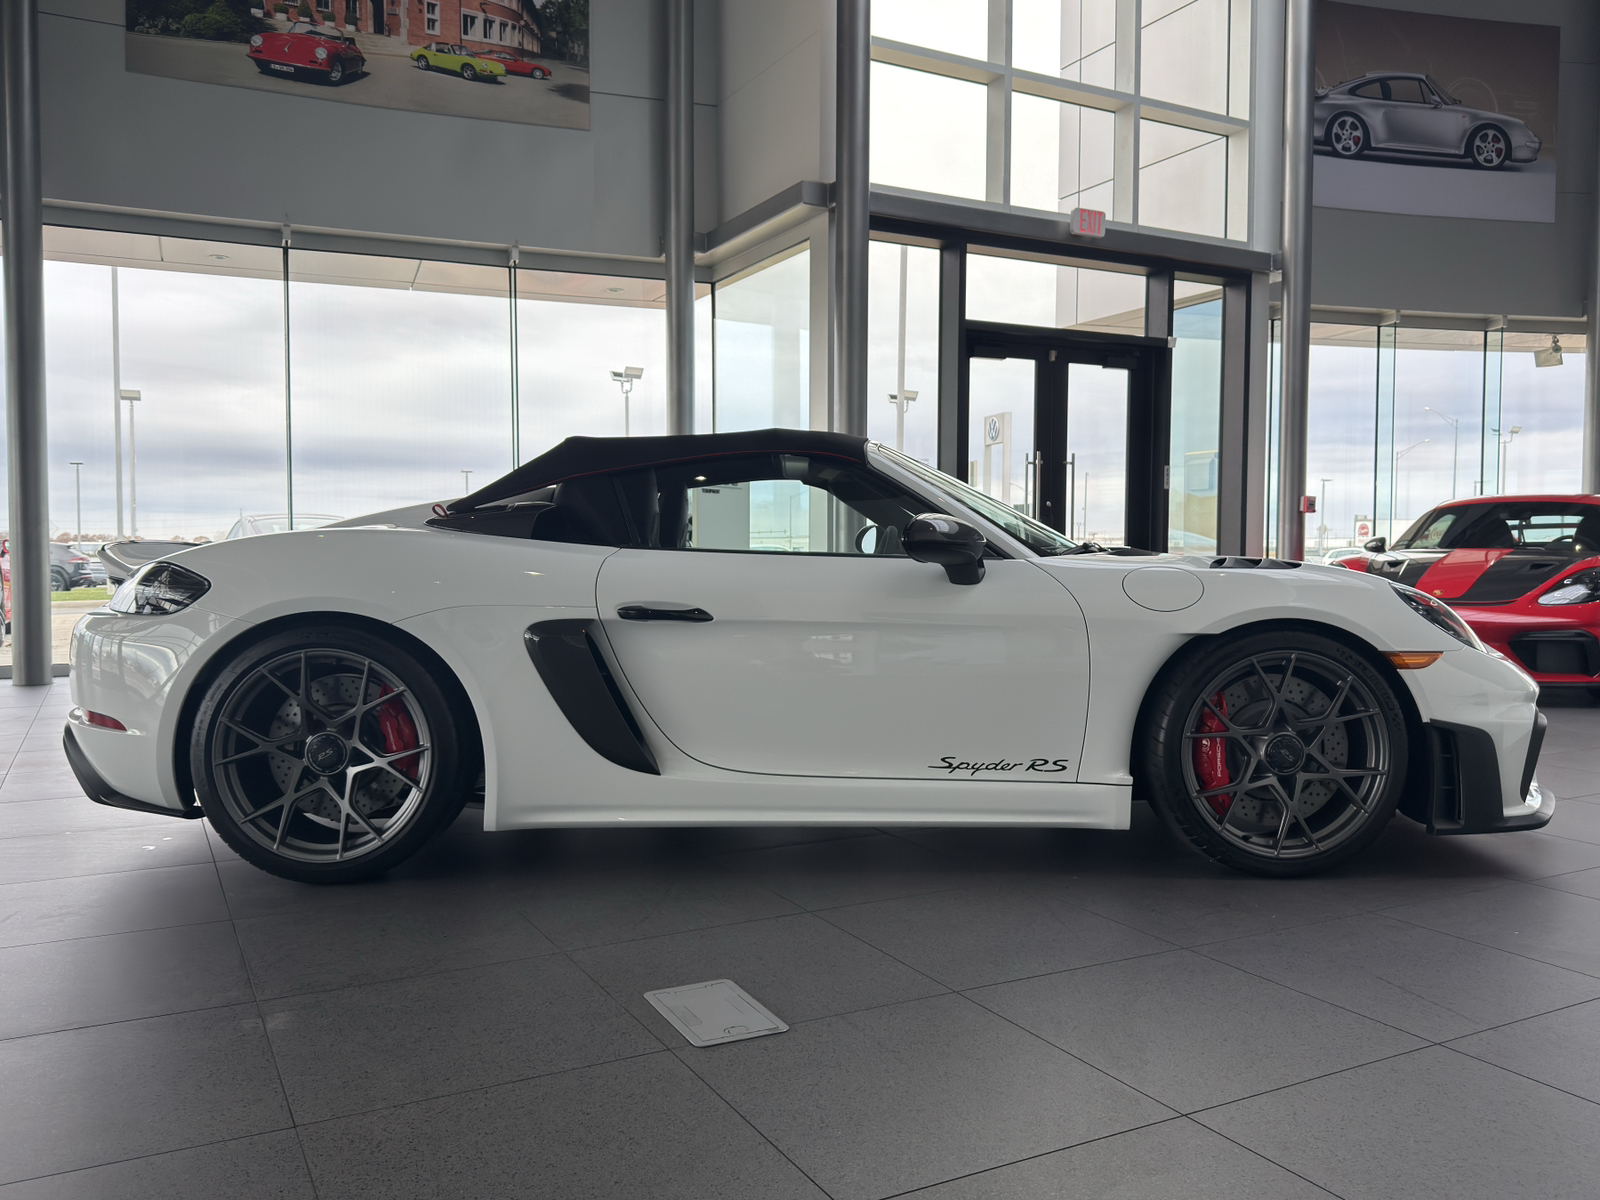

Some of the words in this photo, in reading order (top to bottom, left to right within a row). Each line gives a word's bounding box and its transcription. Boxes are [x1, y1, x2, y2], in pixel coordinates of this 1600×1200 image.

[1080, 209, 1104, 236] EXIT
[317, 748, 333, 761] RS
[1280, 749, 1295, 761] RS
[928, 756, 1023, 776] Spyder
[1025, 758, 1069, 772] RS
